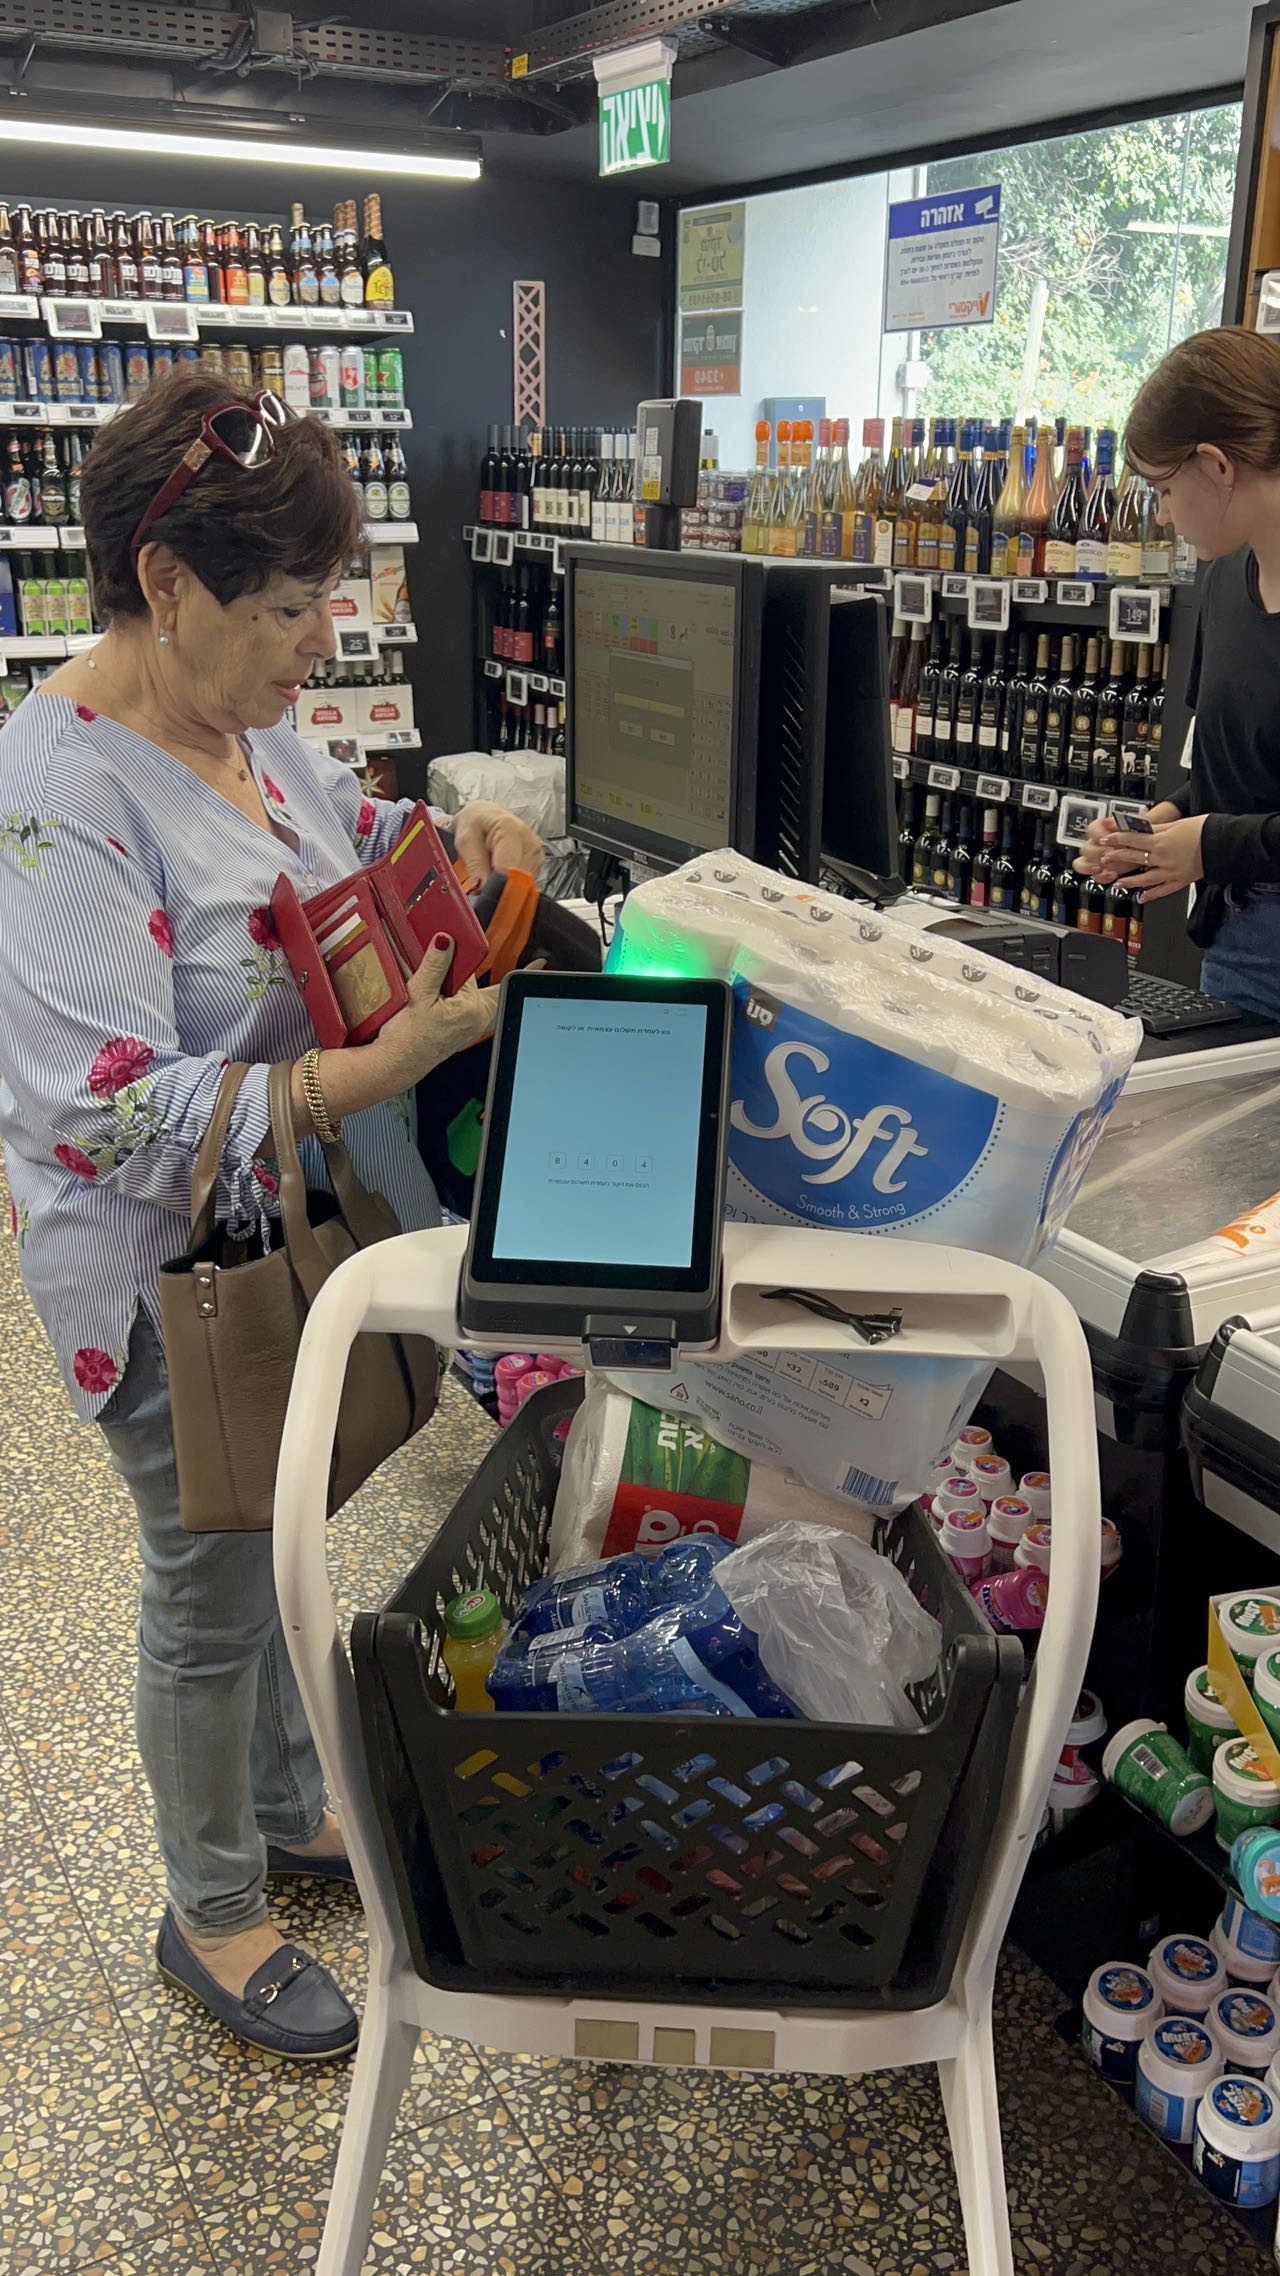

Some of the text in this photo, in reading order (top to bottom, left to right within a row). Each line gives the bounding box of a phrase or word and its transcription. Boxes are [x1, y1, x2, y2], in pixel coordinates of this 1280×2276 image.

[602, 84, 658, 173] יציאה
[920, 203, 965, 228] אזהרה
[747, 997, 774, 1027] סנו
[730, 1041, 929, 1194] Soft
[554, 1157, 561, 1165] 8
[583, 1158, 589, 1166] 4
[612, 1160, 618, 1168] 0
[796, 1193, 907, 1220] Smooth & Strong
[705, 1379, 764, 1415] www.sano.co.il
[1234, 1600, 1262, 1628] MUST
